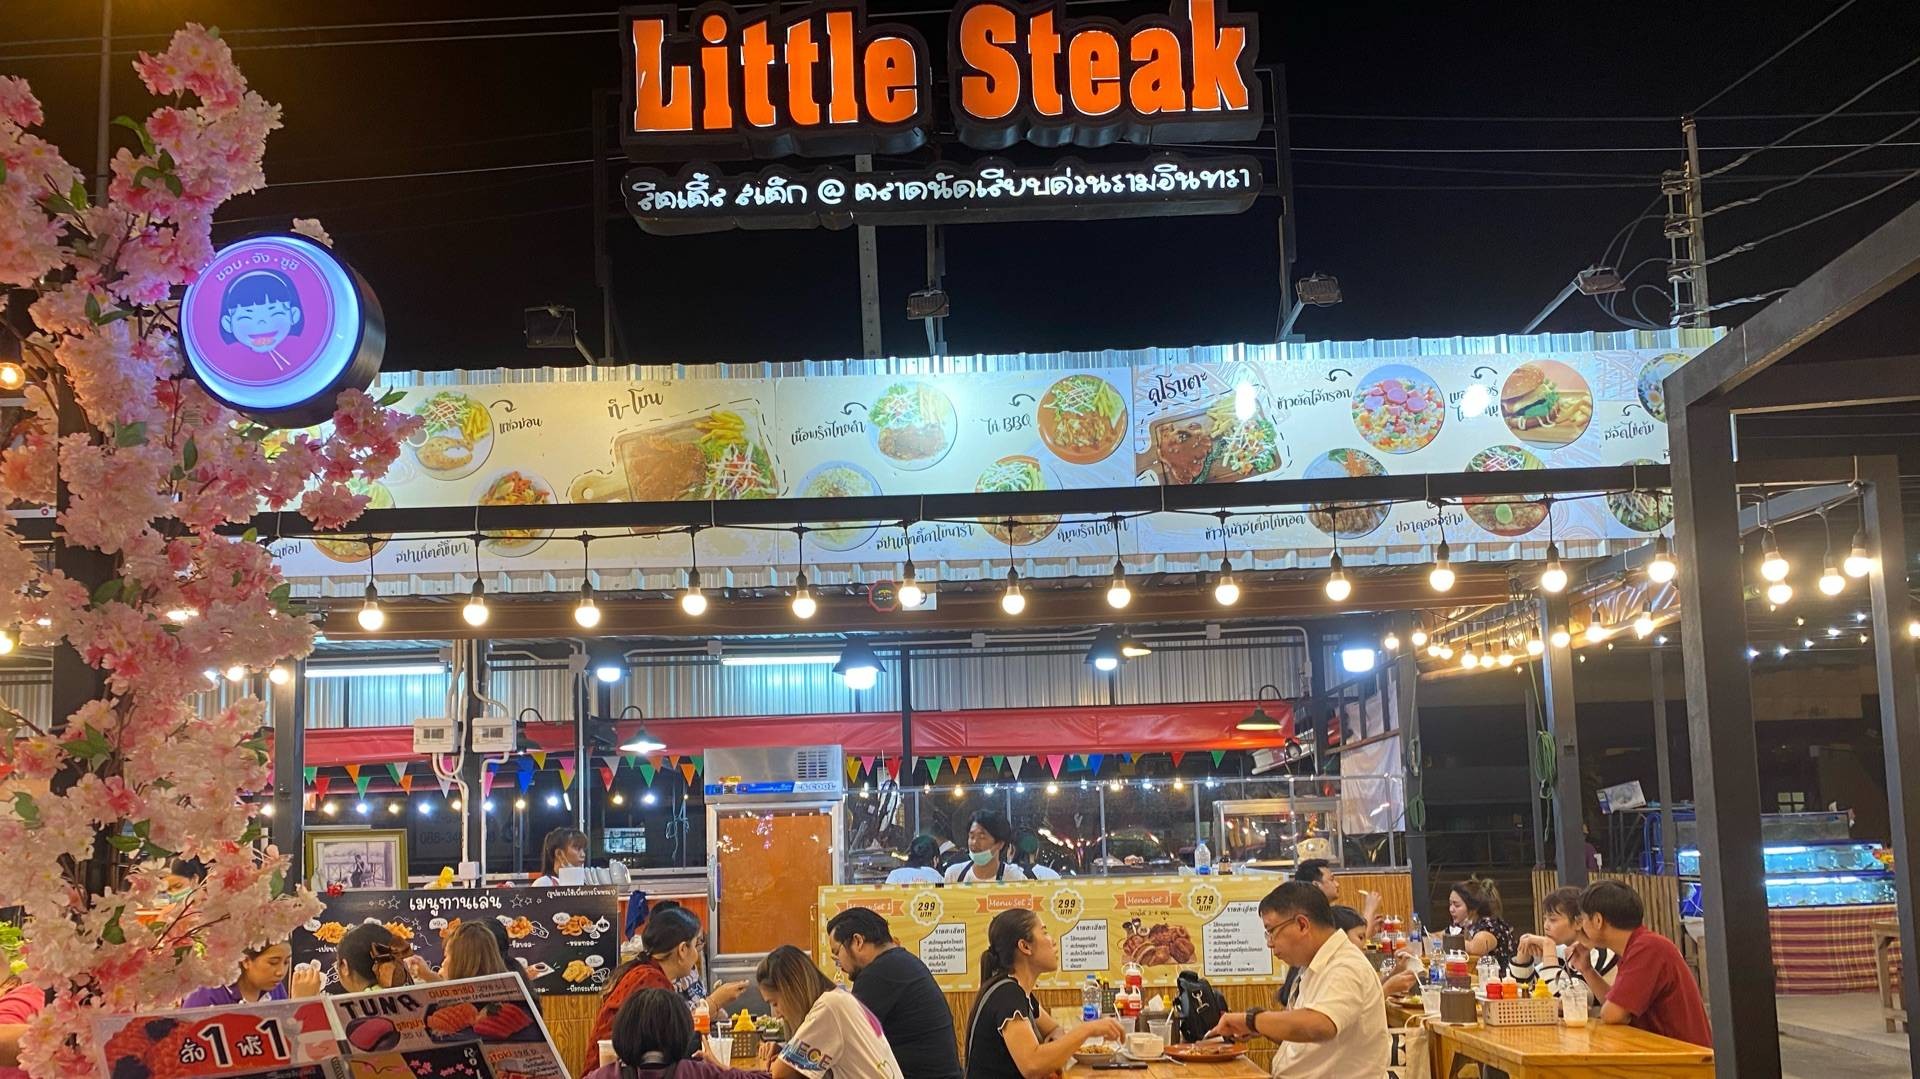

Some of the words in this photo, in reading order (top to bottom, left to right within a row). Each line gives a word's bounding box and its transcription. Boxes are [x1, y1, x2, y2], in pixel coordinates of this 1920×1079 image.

[633, 11, 918, 131] Little
[960, 0, 1249, 119] Steak
[817, 178, 846, 205] @
[1003, 413, 1032, 432] BBQ
[409, 892, 502, 917] เมนูทานเล่น
[918, 902, 935, 912] 299
[1058, 899, 1076, 909] 299
[1196, 895, 1214, 905] 579
[340, 994, 421, 1020] TUNA
[180, 1037, 207, 1065] สั่ง
[198, 1023, 233, 1068] 1
[236, 1036, 264, 1059] ฟรี
[256, 1017, 290, 1061] 1
